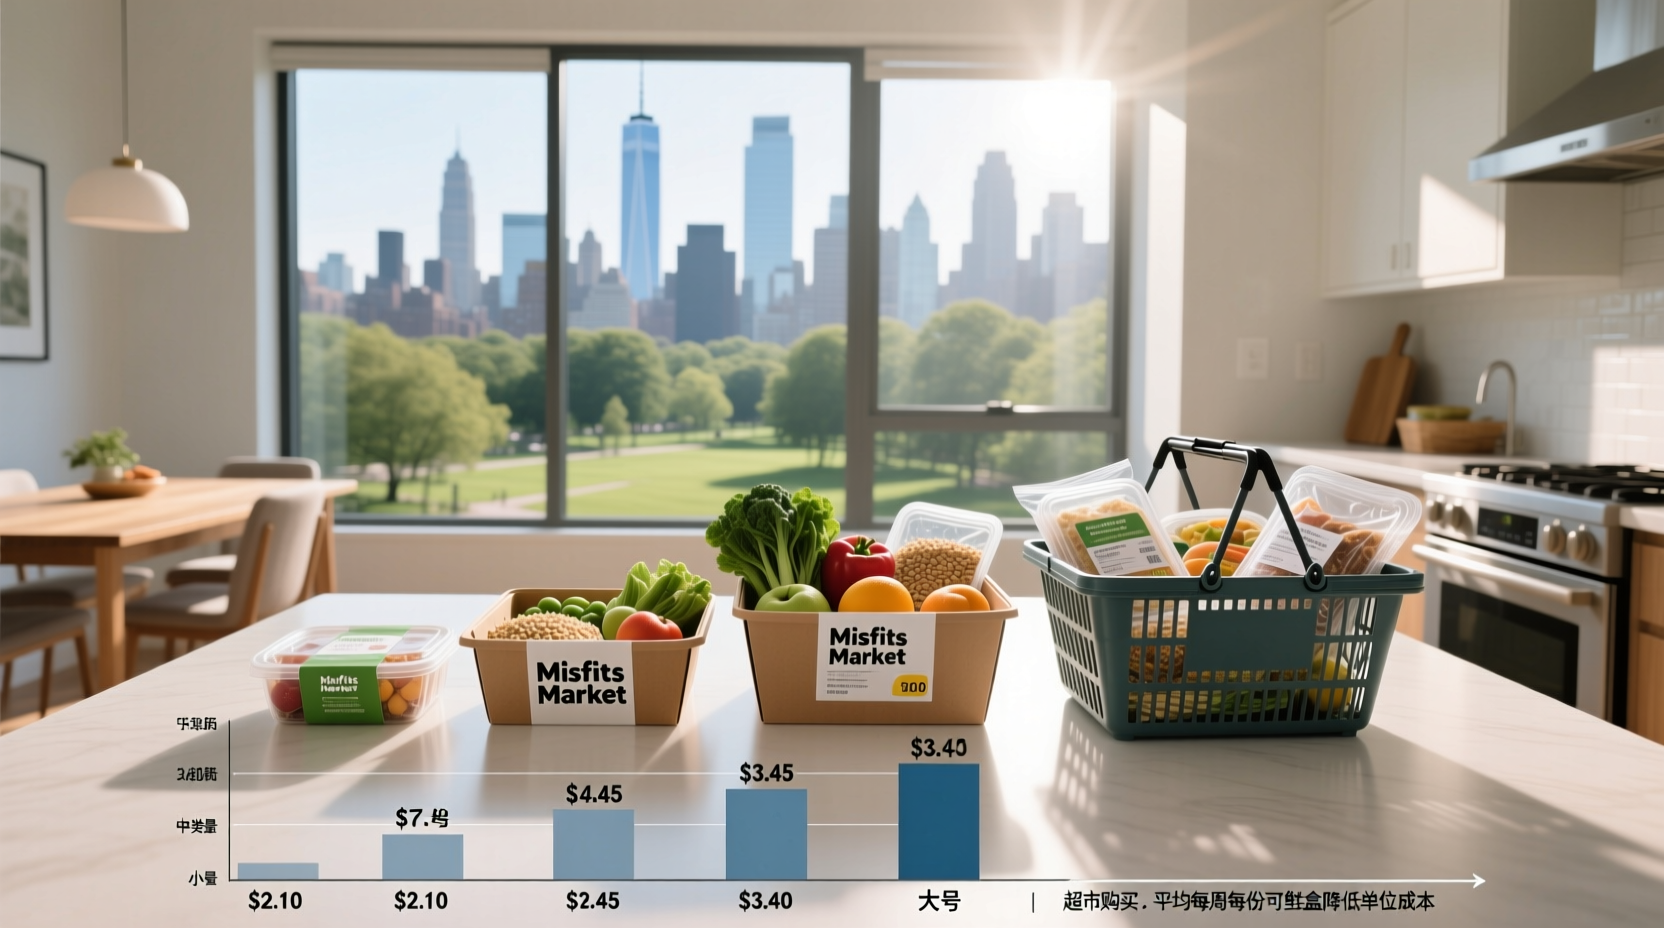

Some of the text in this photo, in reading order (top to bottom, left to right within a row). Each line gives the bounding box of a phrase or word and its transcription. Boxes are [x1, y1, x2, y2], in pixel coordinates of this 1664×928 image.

[830, 626, 908, 647] Misfits
[829, 647, 907, 666] Market
[536, 660, 625, 683] Misfits
[537, 683, 627, 705] Market
